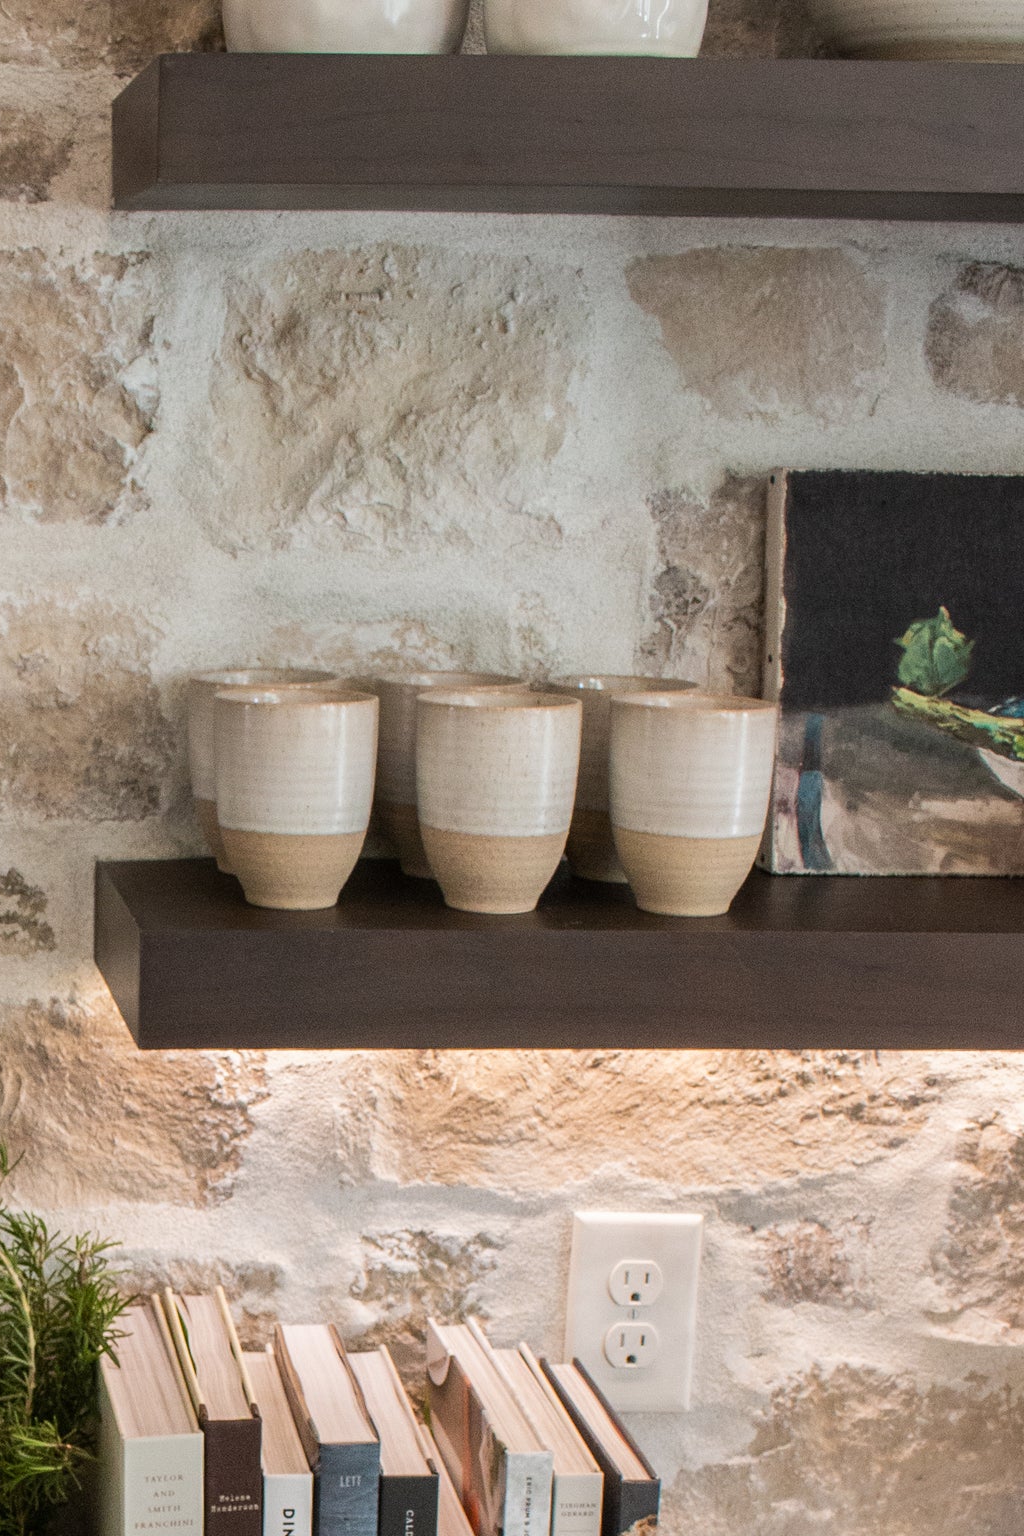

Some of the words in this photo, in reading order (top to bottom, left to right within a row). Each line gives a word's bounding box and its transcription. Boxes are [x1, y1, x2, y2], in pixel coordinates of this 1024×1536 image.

[145, 1474, 184, 1483] TAYLOR
[340, 1475, 362, 1488] LETT
[153, 1490, 175, 1498] AND
[219, 1494, 251, 1502] Helene
[148, 1505, 181, 1513] SMITH
[211, 1503, 260, 1513] Henderson
[135, 1519, 194, 1529] FRANCHINI
